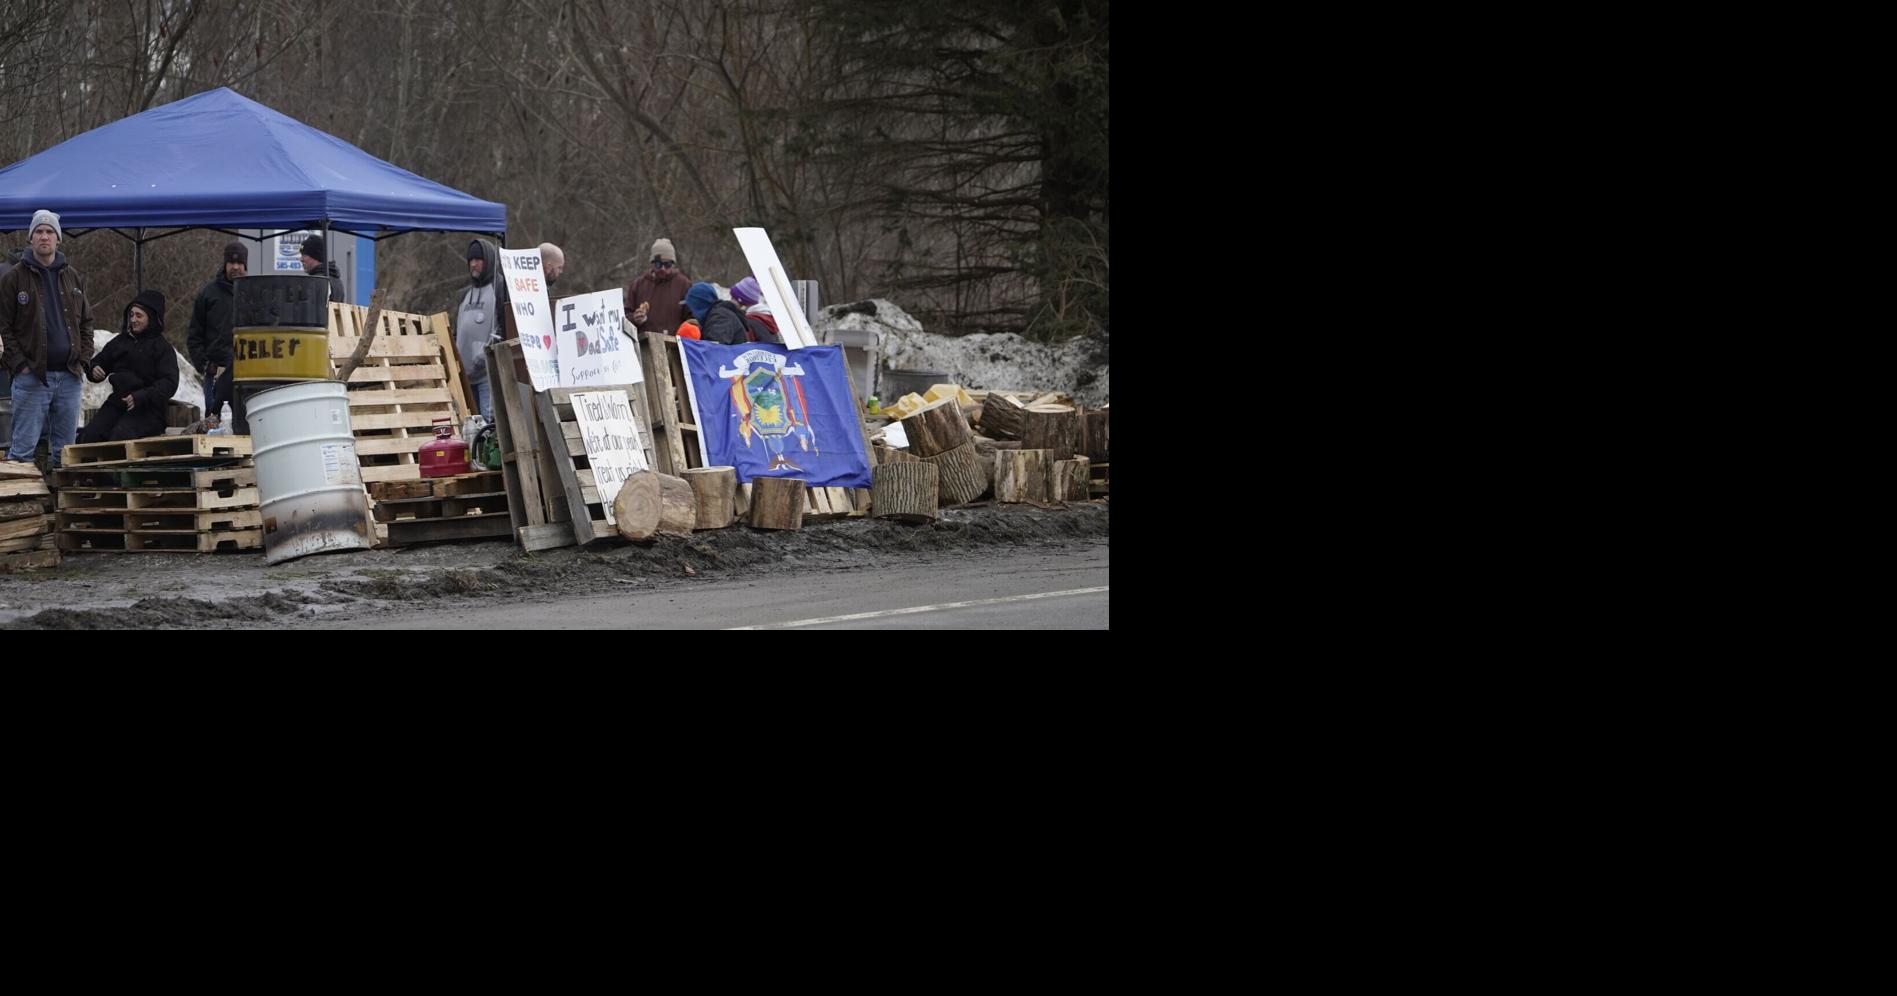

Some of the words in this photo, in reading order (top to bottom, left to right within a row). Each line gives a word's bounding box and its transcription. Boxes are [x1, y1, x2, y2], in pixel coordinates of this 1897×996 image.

[513, 256, 540, 270] KEEP
[515, 278, 540, 292] SAFE
[514, 302, 535, 315] WHO
[562, 303, 577, 332] I
